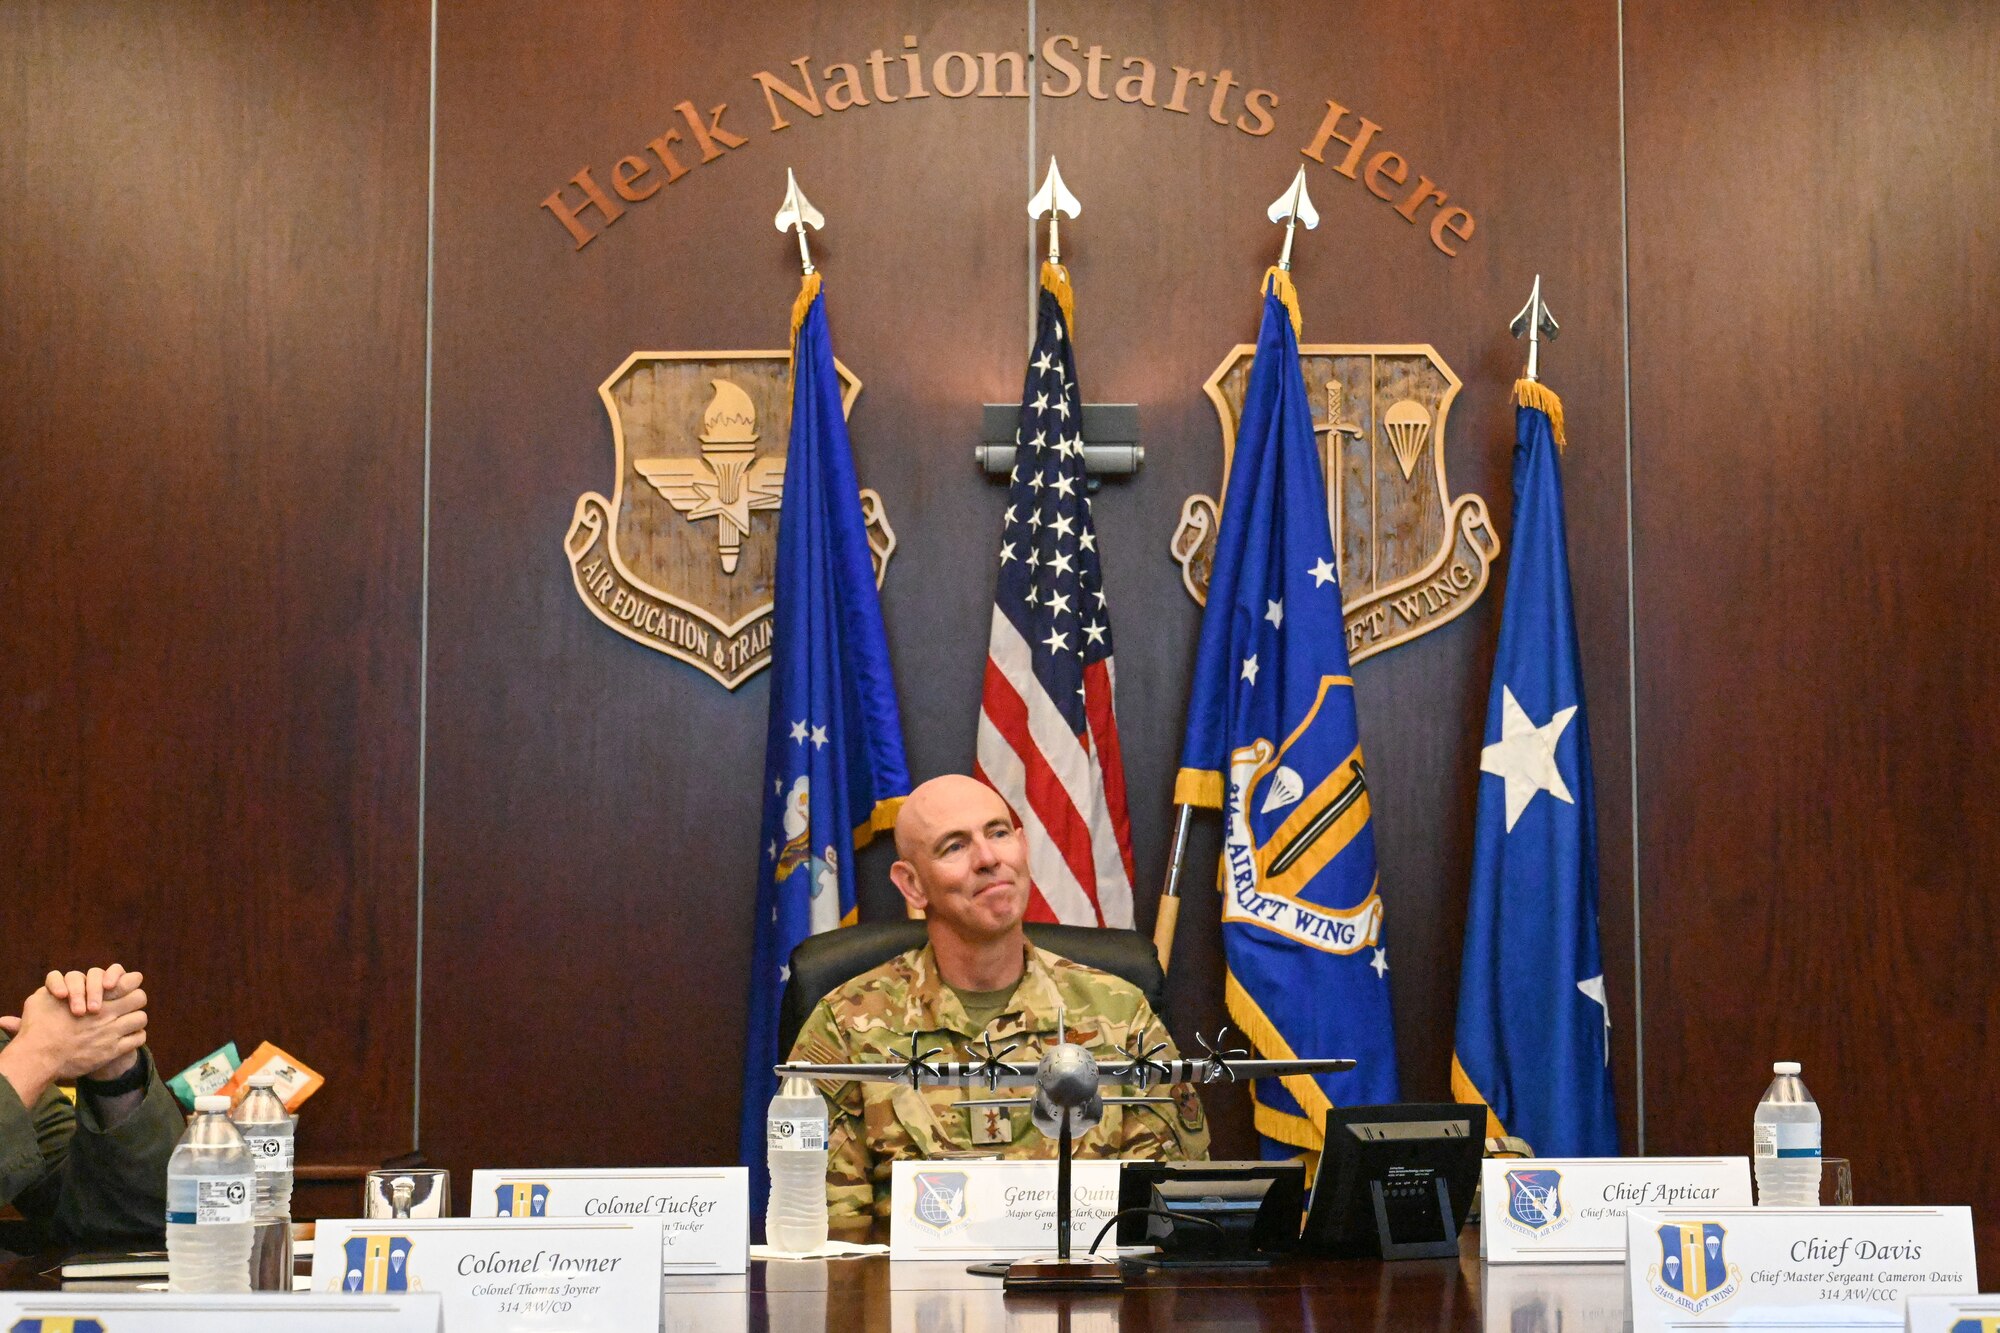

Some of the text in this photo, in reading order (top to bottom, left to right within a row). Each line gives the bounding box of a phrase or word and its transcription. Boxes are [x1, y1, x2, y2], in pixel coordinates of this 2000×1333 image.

[540, 34, 1476, 257] Herk Nation Starts Here
[1392, 562, 1473, 623] WING
[582, 559, 613, 604] AIR
[609, 588, 710, 658] EDUCATION
[713, 640, 726, 671] &
[1227, 843, 1288, 921] AIRLIFT
[1294, 907, 1356, 944] WING
[1004, 1185, 1119, 1207] Gener Quin
[1602, 1182, 1720, 1206] Chief Apticar
[585, 1194, 717, 1217] Colonel Tucker
[1005, 1208, 1032, 1220] Major
[1580, 1208, 1605, 1220] Chief
[673, 1221, 704, 1232] Tucker
[1042, 1222, 1053, 1231] 19
[1540, 1228, 1551, 1238] AIR
[1790, 1237, 1922, 1267] Chief Davis
[457, 1251, 622, 1280] Colonel Joyner
[1750, 1270, 1963, 1285] Chief Master Sergeant Cameron Davis
[472, 1283, 601, 1298] Colonel Thomas Joyner
[1654, 1284, 1735, 1313] 314th AIRLIFT WING
[1819, 1287, 1898, 1302] 314 AW/CCC
[498, 1301, 519, 1313] 314
